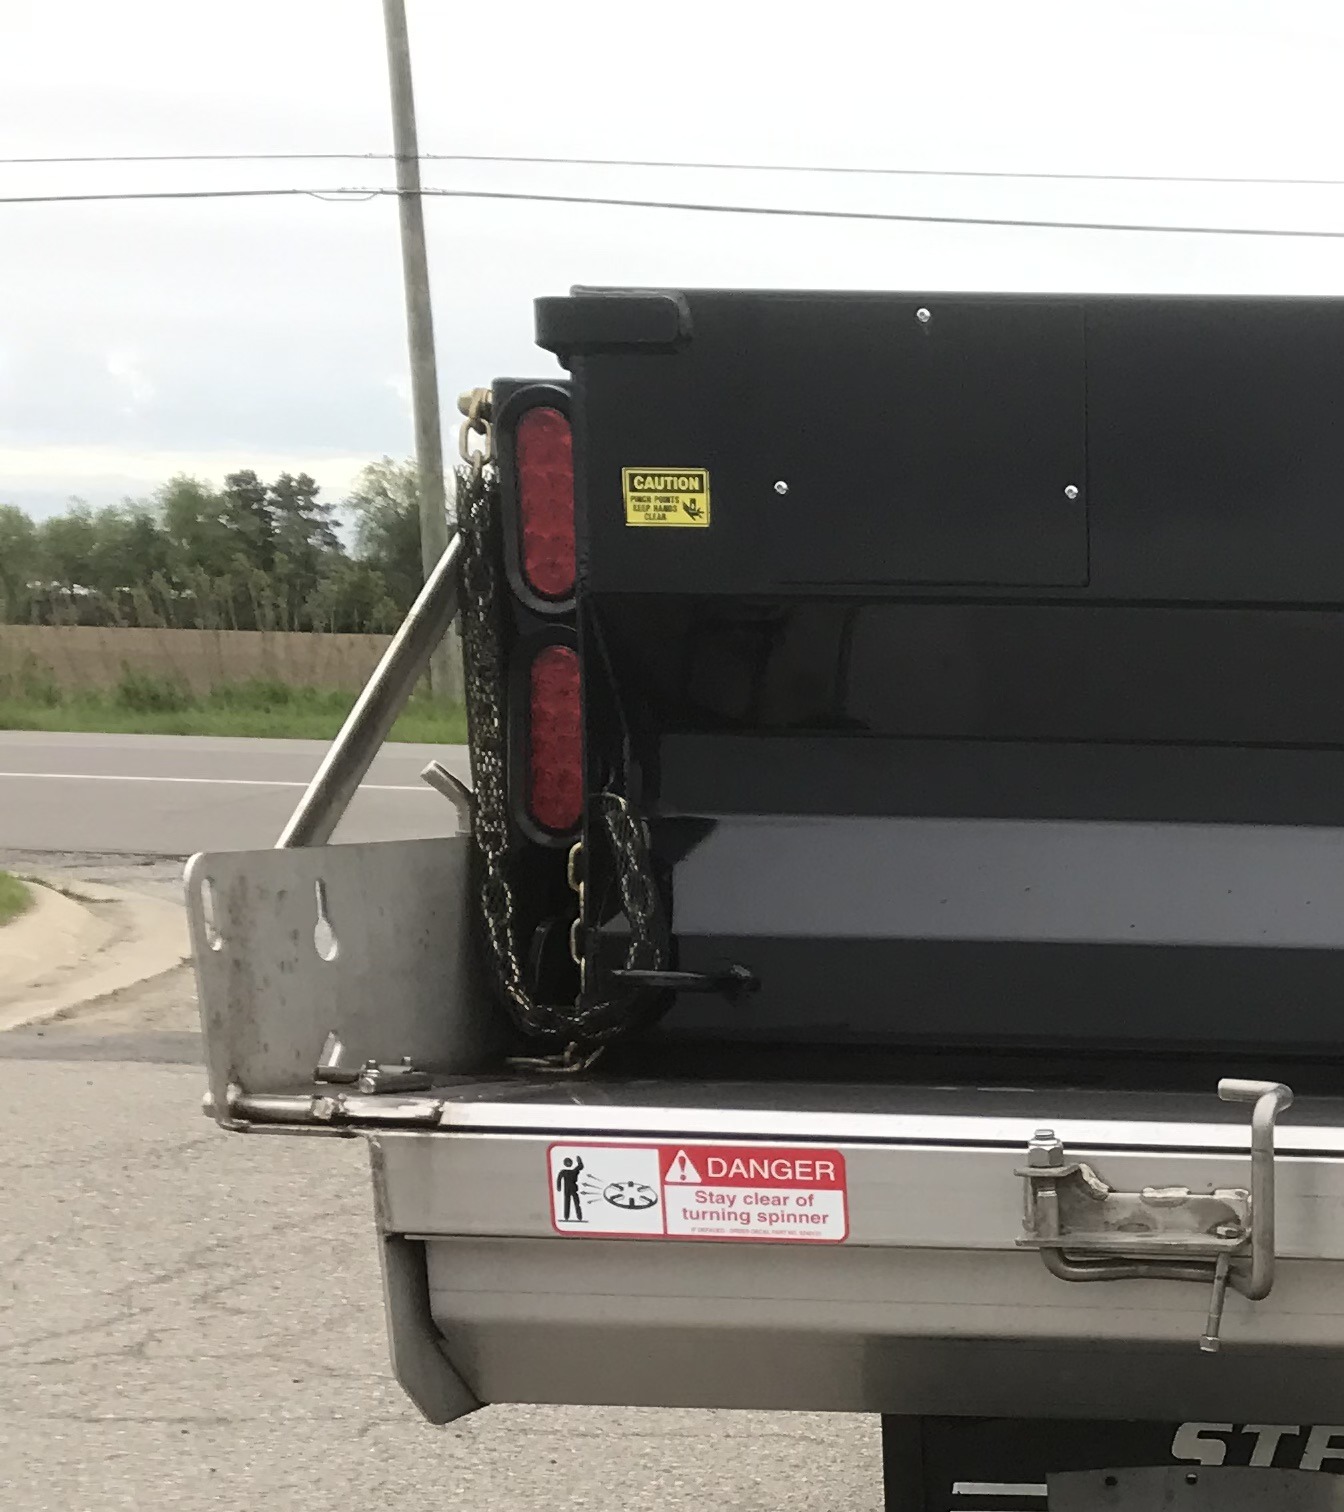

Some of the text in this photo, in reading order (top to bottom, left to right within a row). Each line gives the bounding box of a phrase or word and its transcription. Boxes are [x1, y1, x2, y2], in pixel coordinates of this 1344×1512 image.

[634, 475, 699, 490] CAUTION
[707, 1156, 836, 1182] DANGER
[694, 1190, 815, 1208] Stay clear of
[682, 1208, 829, 1226] turning spinner
